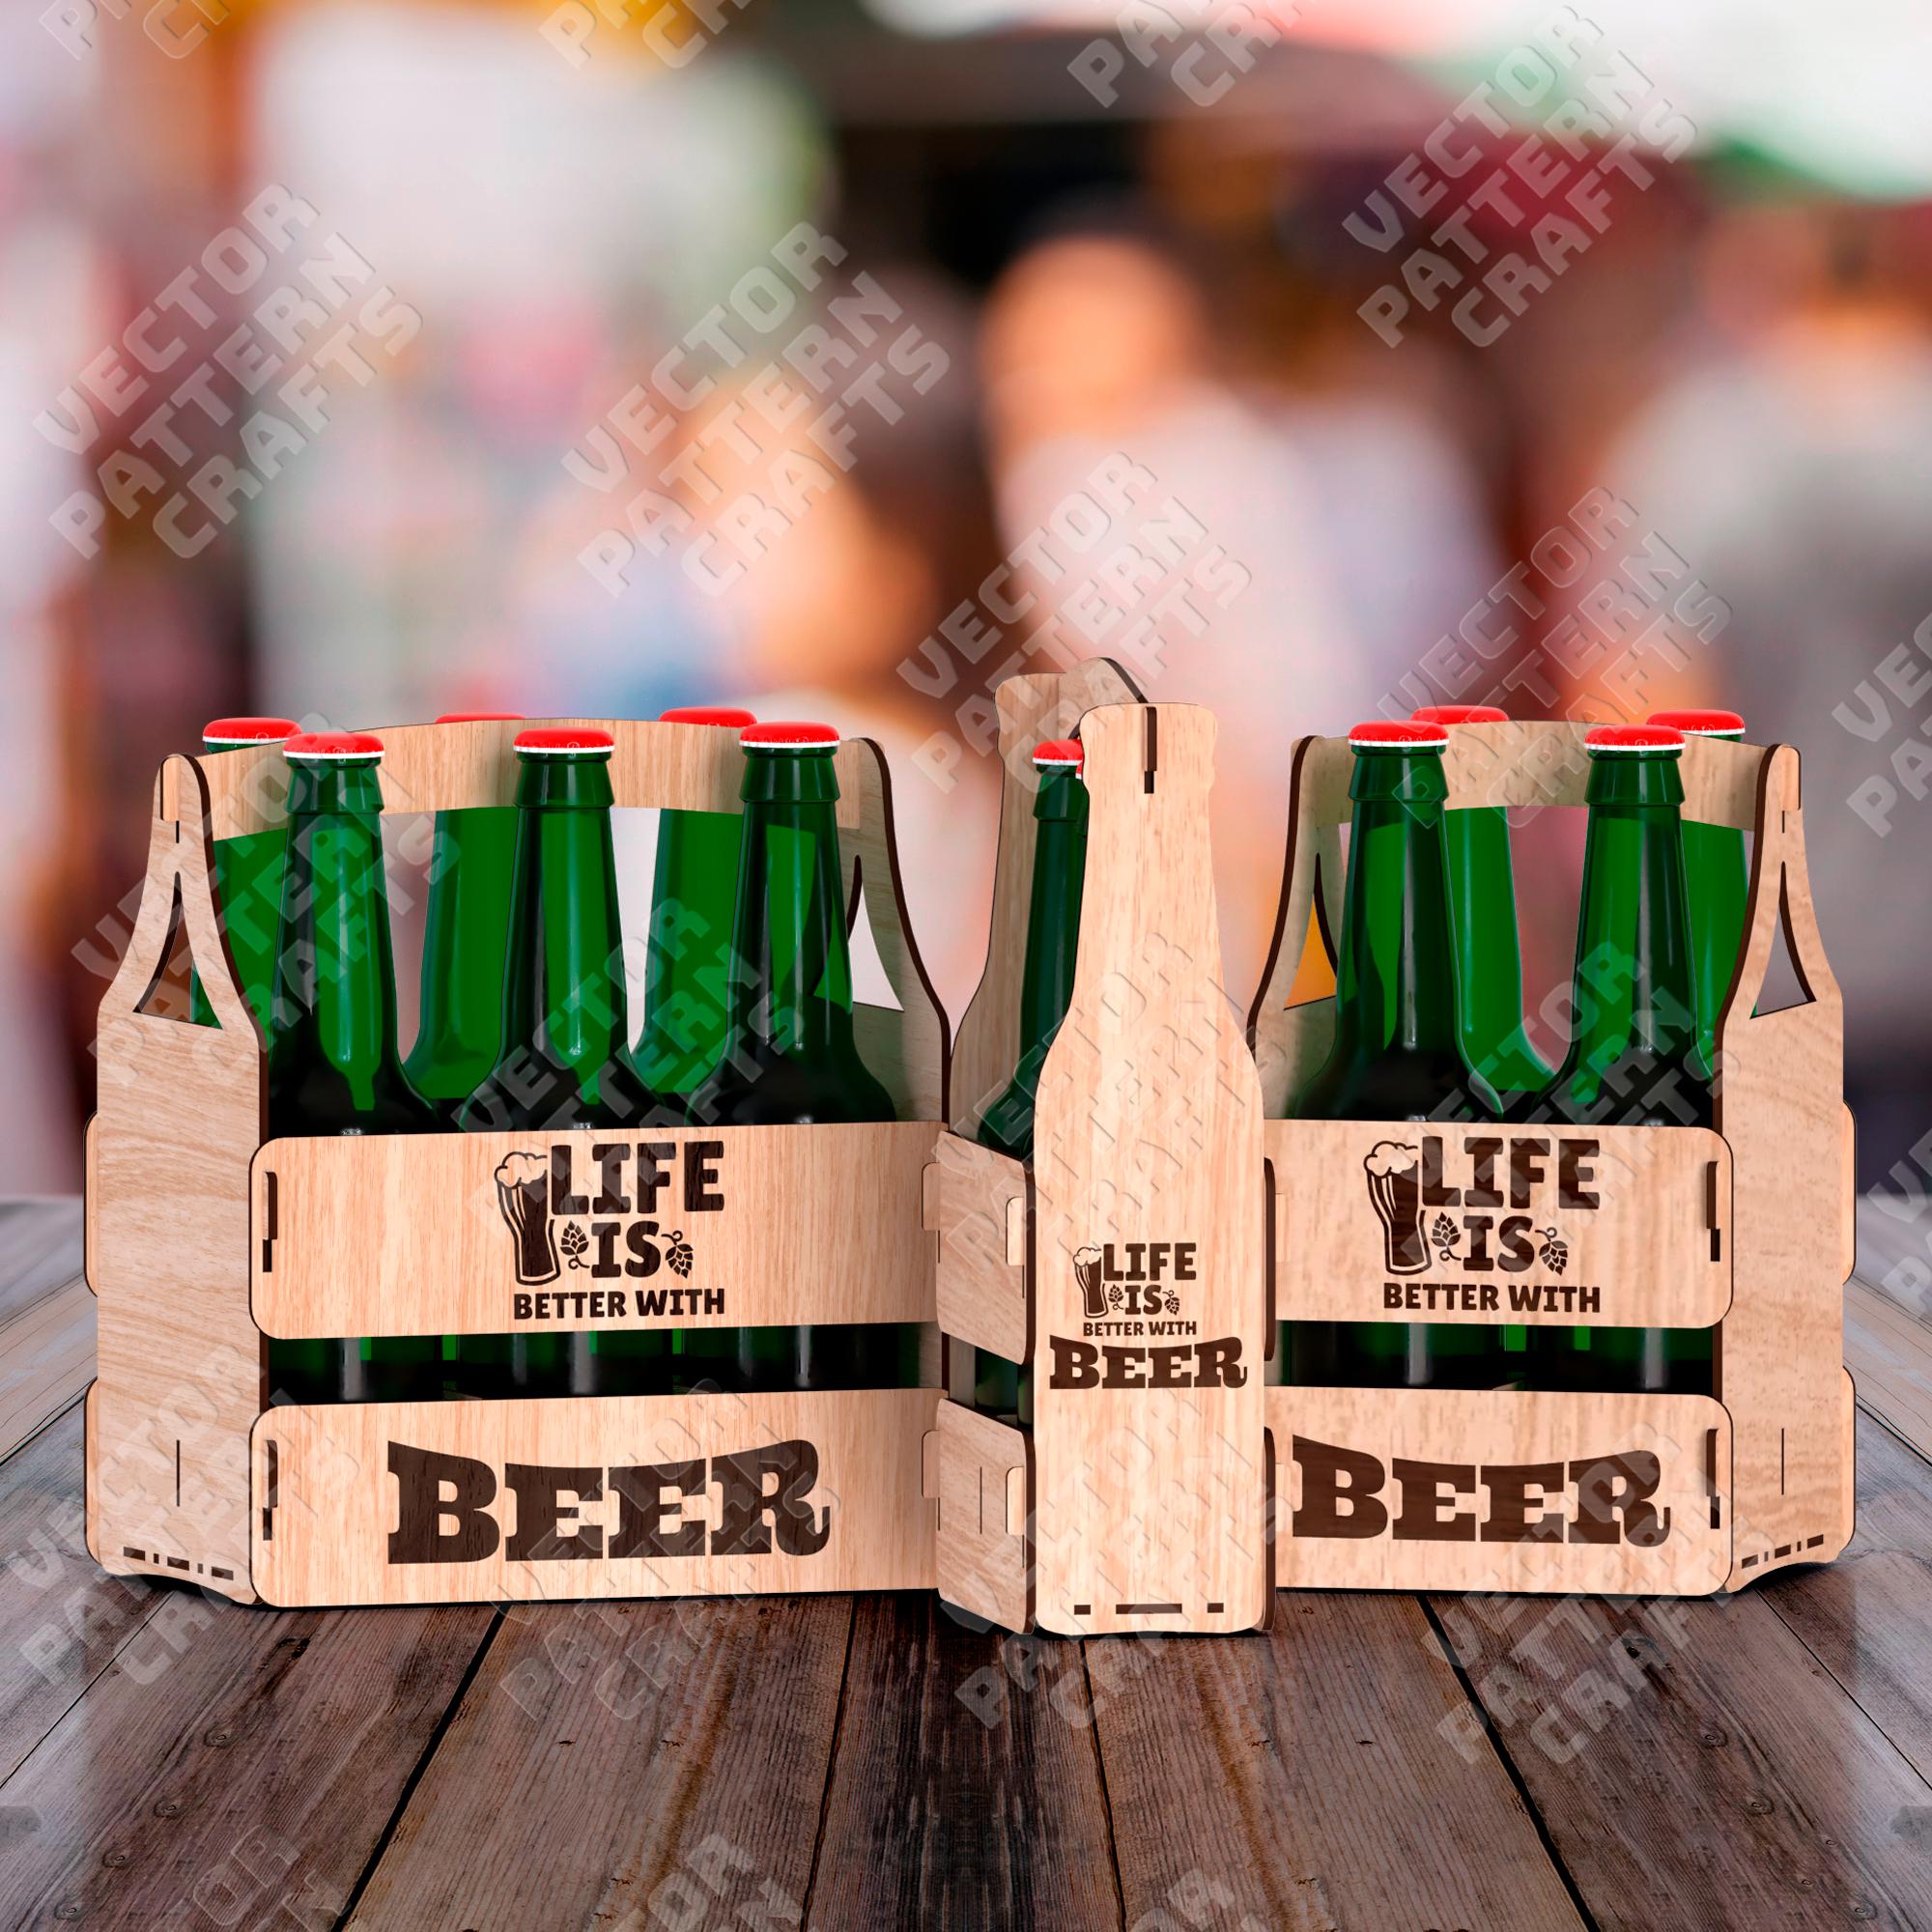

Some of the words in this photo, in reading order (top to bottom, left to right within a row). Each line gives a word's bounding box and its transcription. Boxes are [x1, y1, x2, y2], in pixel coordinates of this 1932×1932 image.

[552, 1141, 724, 1215] LIFE
[1422, 1136, 1601, 1209] LIFE
[591, 1221, 661, 1278] IS
[1103, 1242, 1197, 1281] LIFE
[1463, 1215, 1535, 1272] IS
[514, 1289, 627, 1320] BETTER
[636, 1288, 724, 1317] WITH
[1124, 1285, 1163, 1315] IS
[1383, 1282, 1500, 1312] BETTER
[1508, 1284, 1601, 1314] WITH
[1083, 1321, 1145, 1337] BETTER
[1149, 1321, 1197, 1336] WITH
[1049, 1334, 1248, 1390] BEER
[387, 1438, 831, 1565] BEER
[1292, 1434, 1671, 1548] BEER
